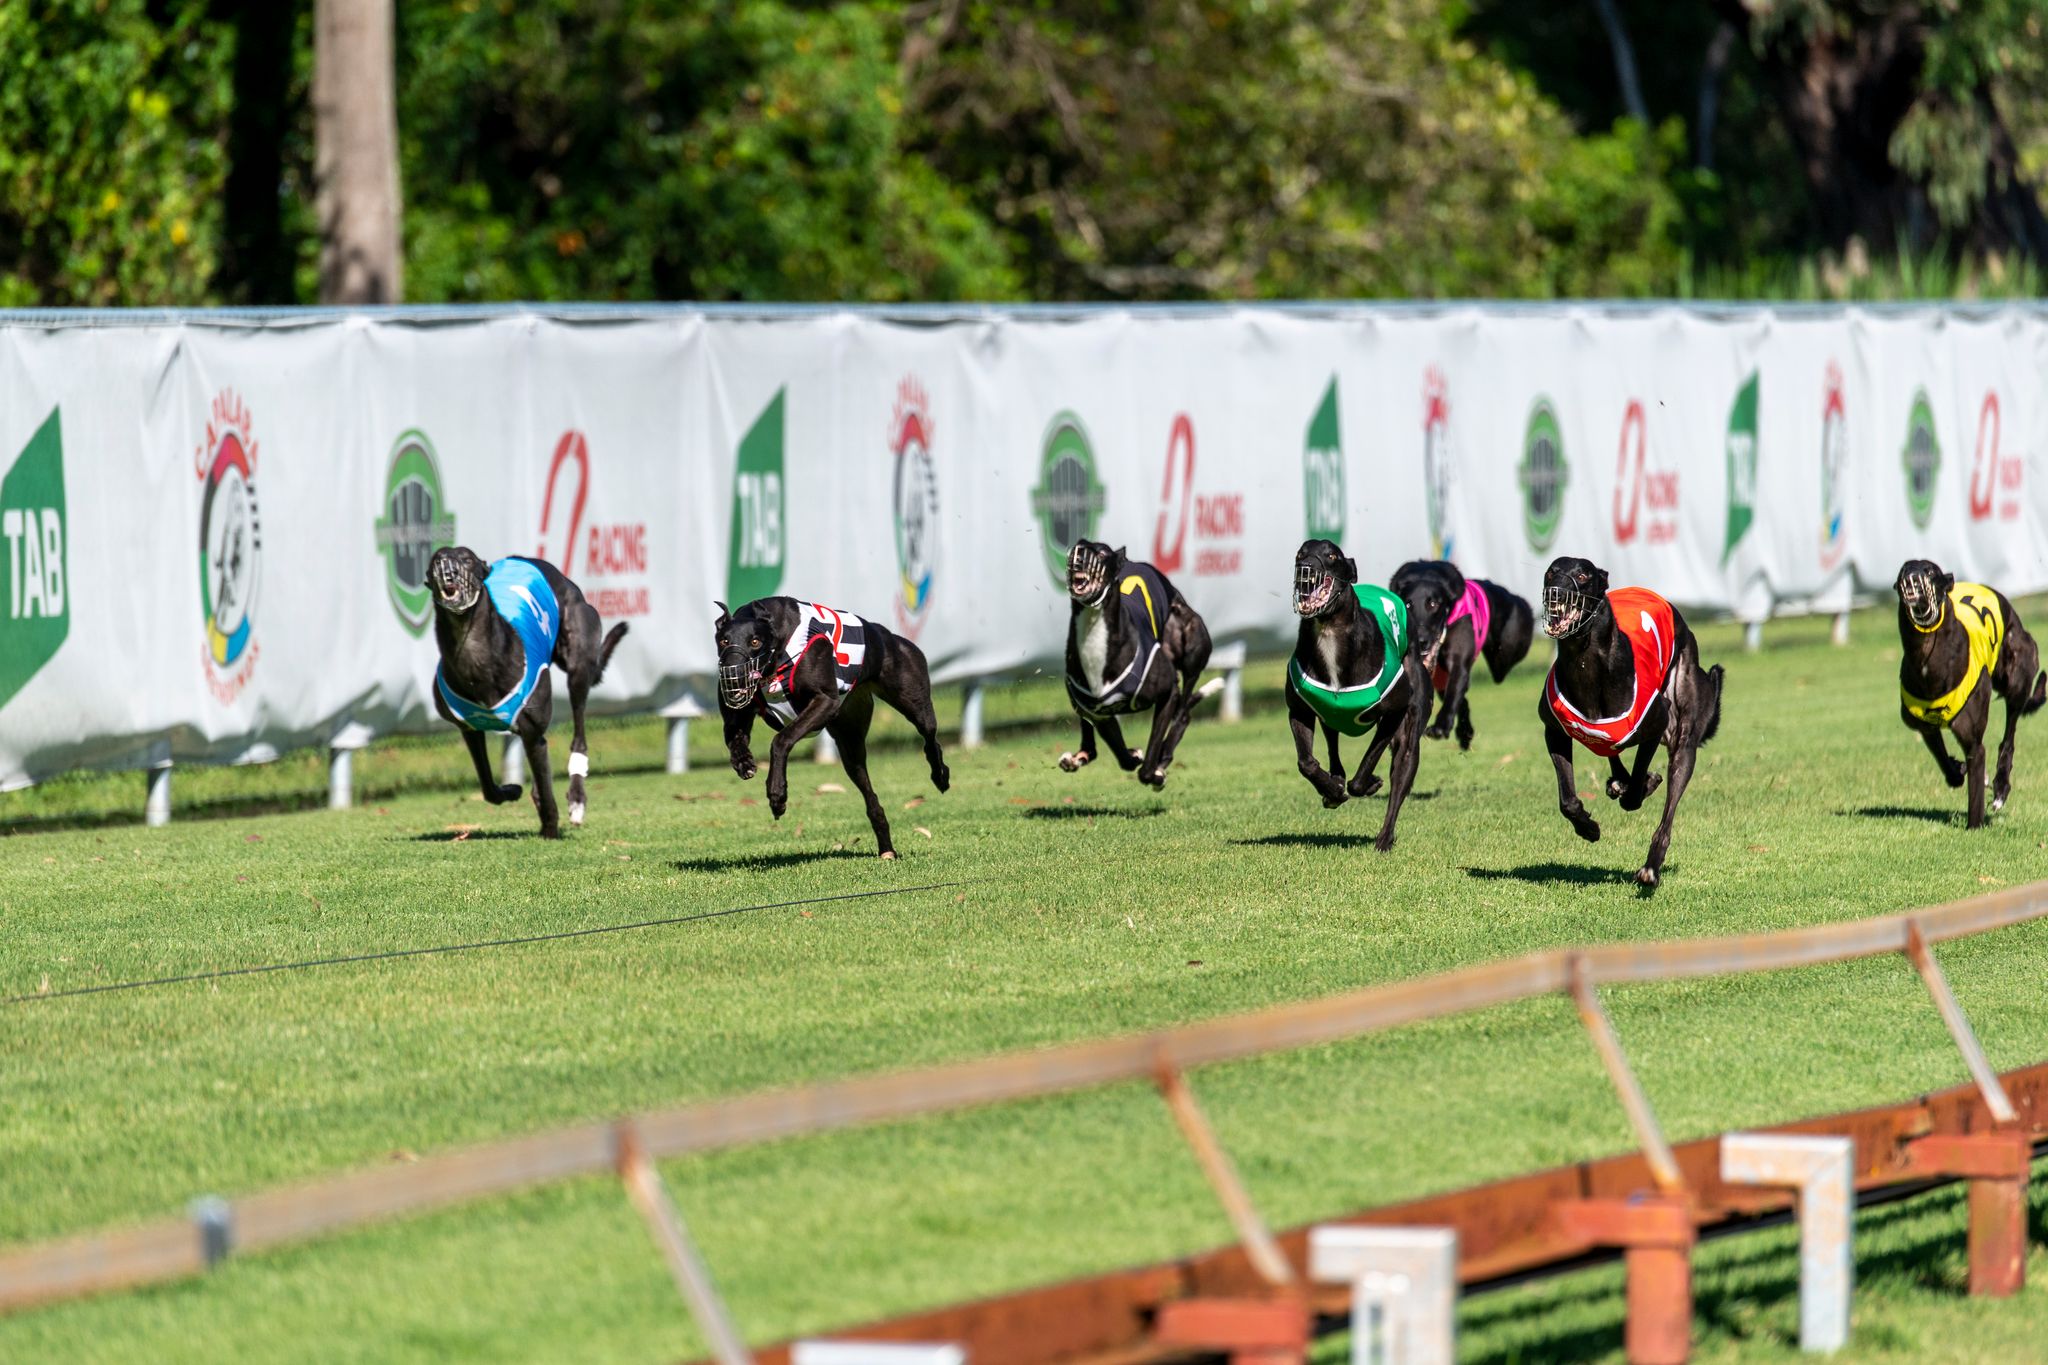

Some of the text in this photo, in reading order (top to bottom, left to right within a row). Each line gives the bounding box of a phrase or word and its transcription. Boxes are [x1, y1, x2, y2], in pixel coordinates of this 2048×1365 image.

[587, 522, 648, 576] RACING
[738, 472, 781, 567] TAB
[3, 507, 64, 619] TAB
[810, 602, 850, 668] 2
[1959, 595, 1999, 653] 5
